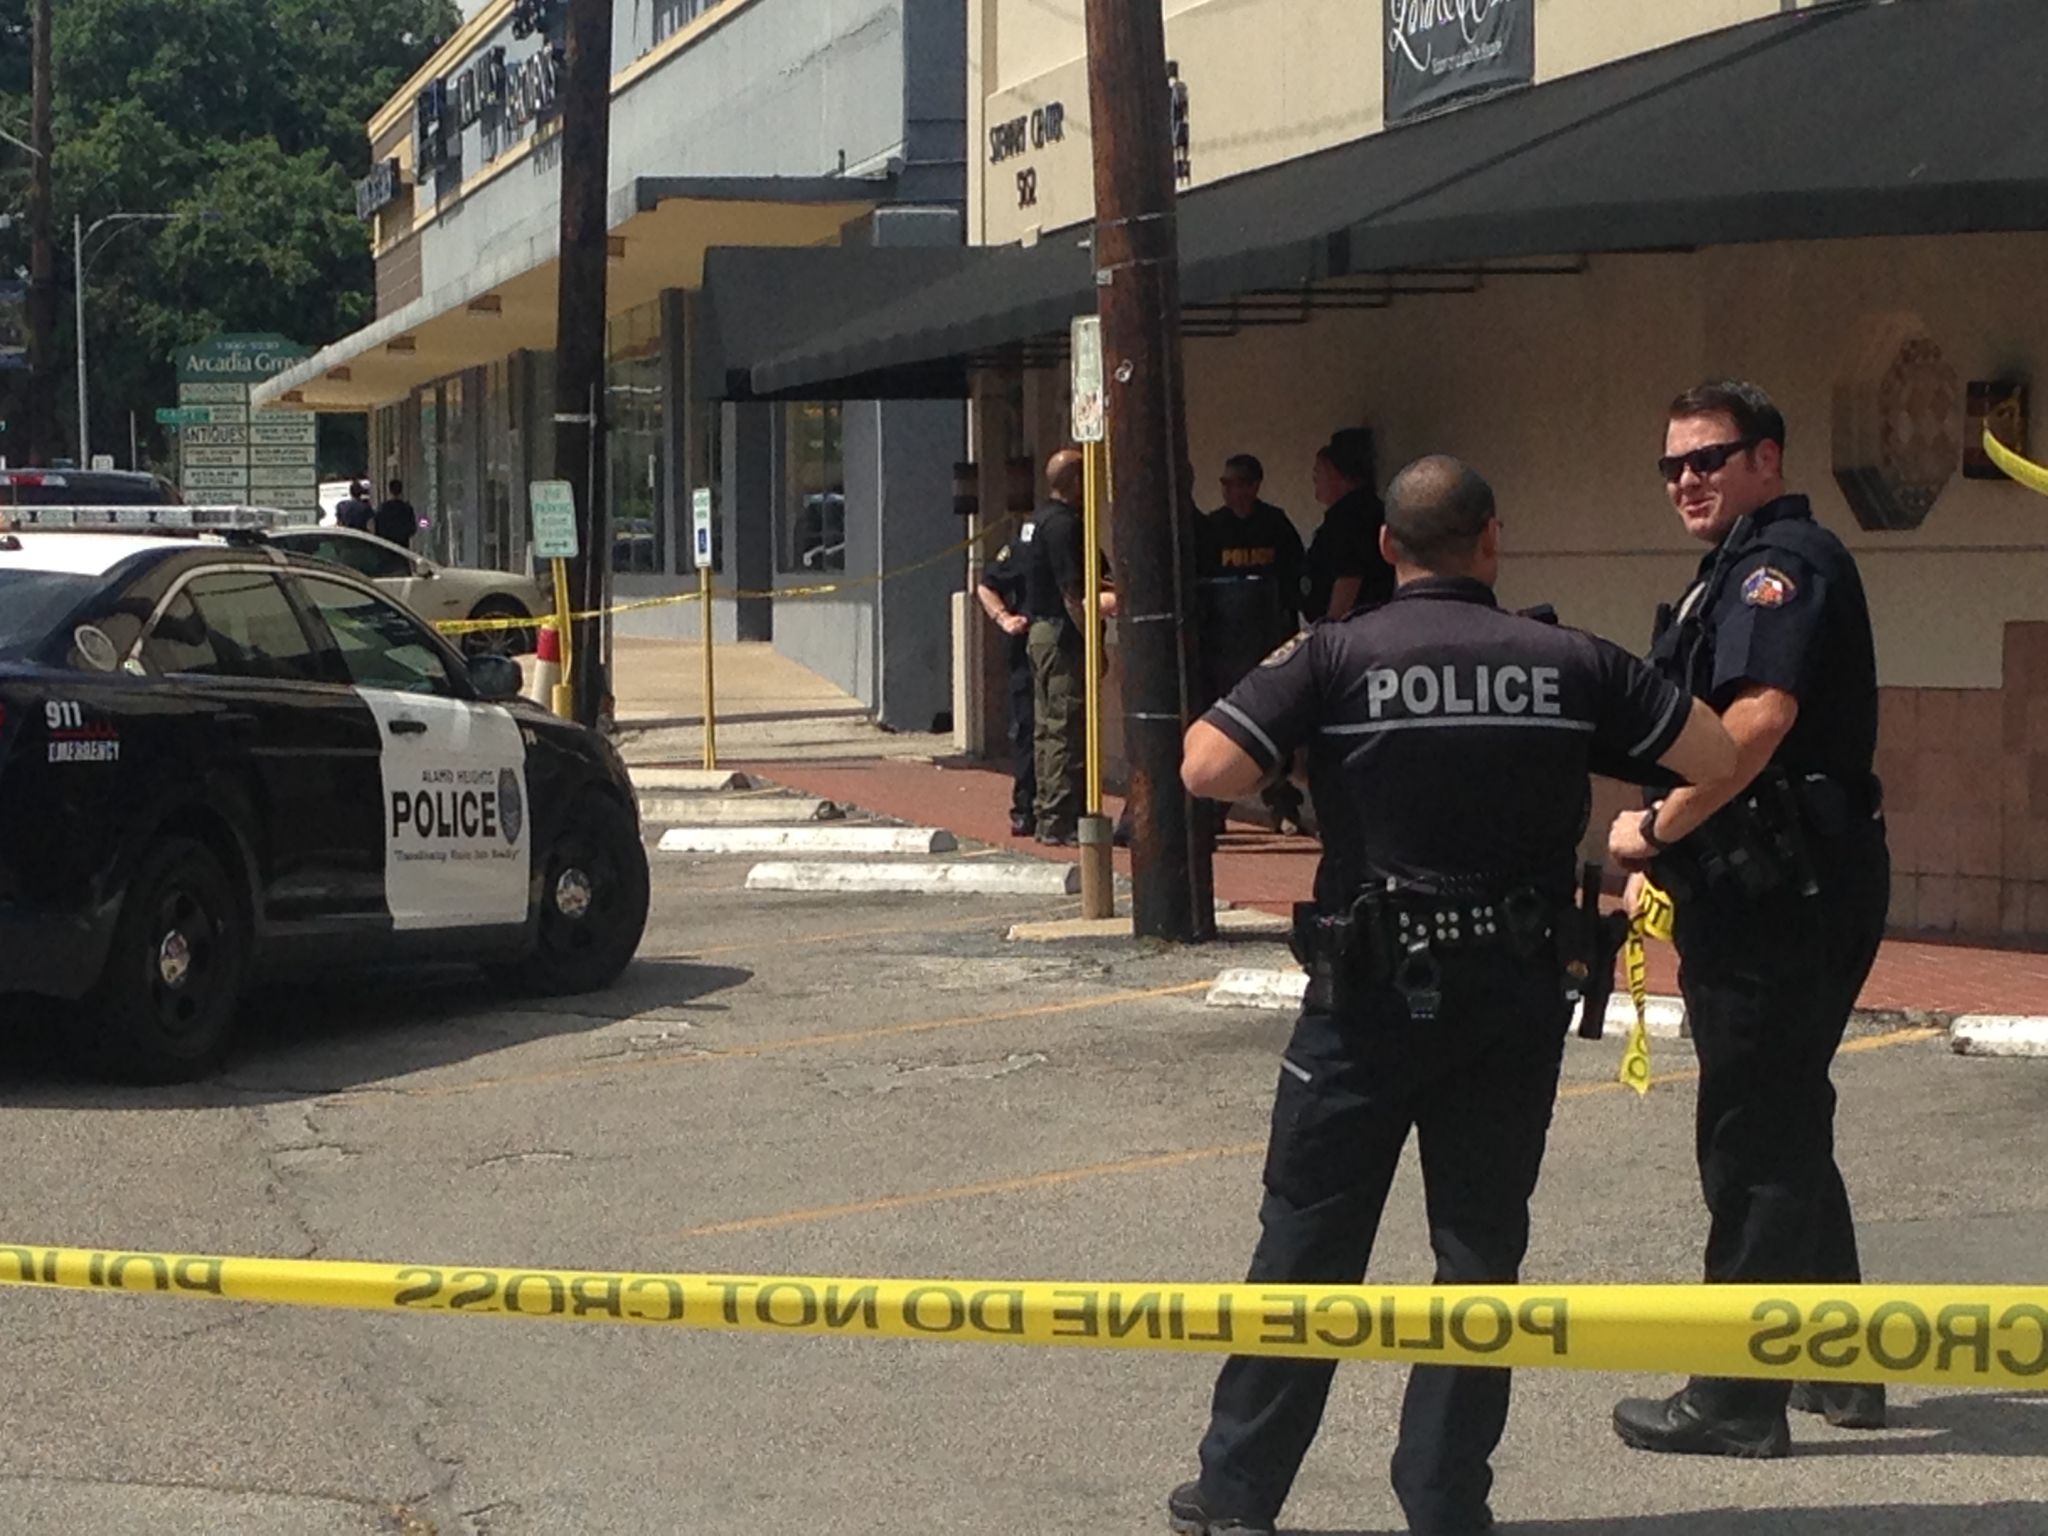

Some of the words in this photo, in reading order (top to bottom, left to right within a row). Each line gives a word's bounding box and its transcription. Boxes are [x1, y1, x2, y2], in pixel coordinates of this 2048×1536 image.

[186, 350, 252, 373] Arcadia
[1366, 664, 1561, 719] POLICE
[45, 700, 82, 729] 911
[422, 769, 454, 783] ALAMO
[391, 789, 497, 838] POLICE
